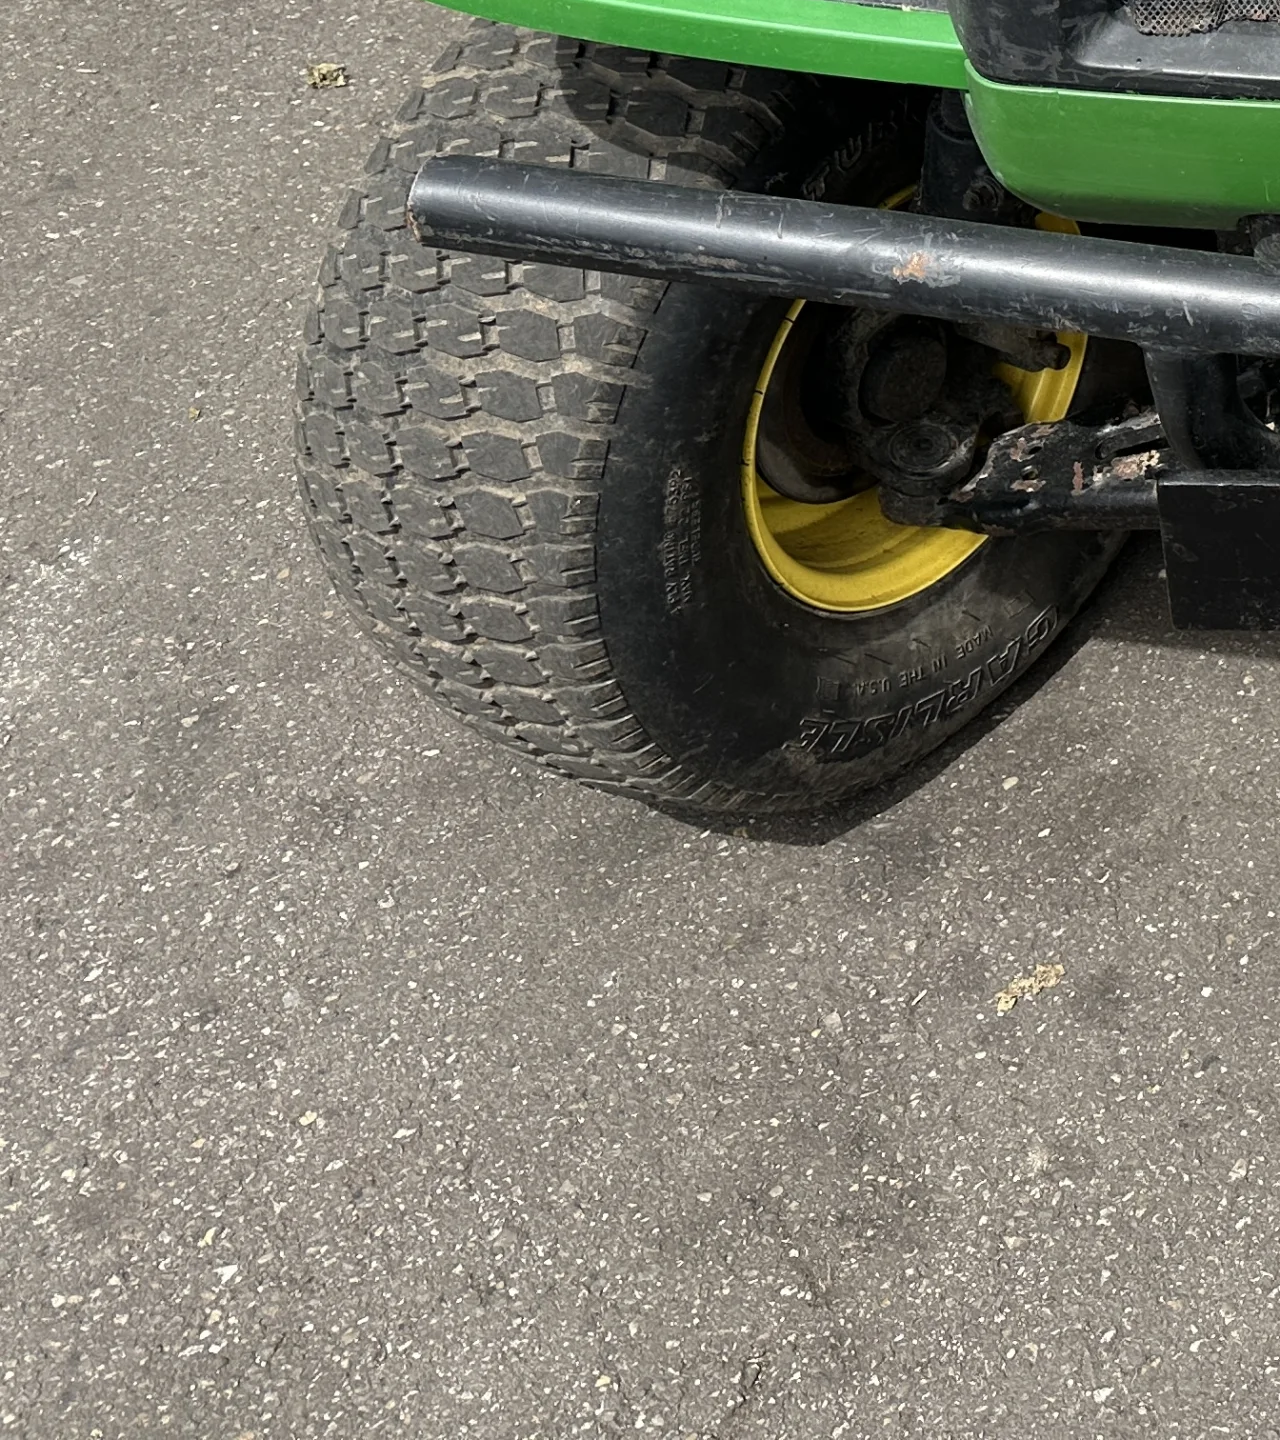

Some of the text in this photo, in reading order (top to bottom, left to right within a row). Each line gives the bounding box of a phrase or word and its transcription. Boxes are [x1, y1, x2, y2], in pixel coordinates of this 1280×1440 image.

[956, 624, 993, 660] MADE
[781, 603, 1060, 754] CARLISLE
[931, 655, 949, 674] IN
[898, 669, 927, 689] THE
